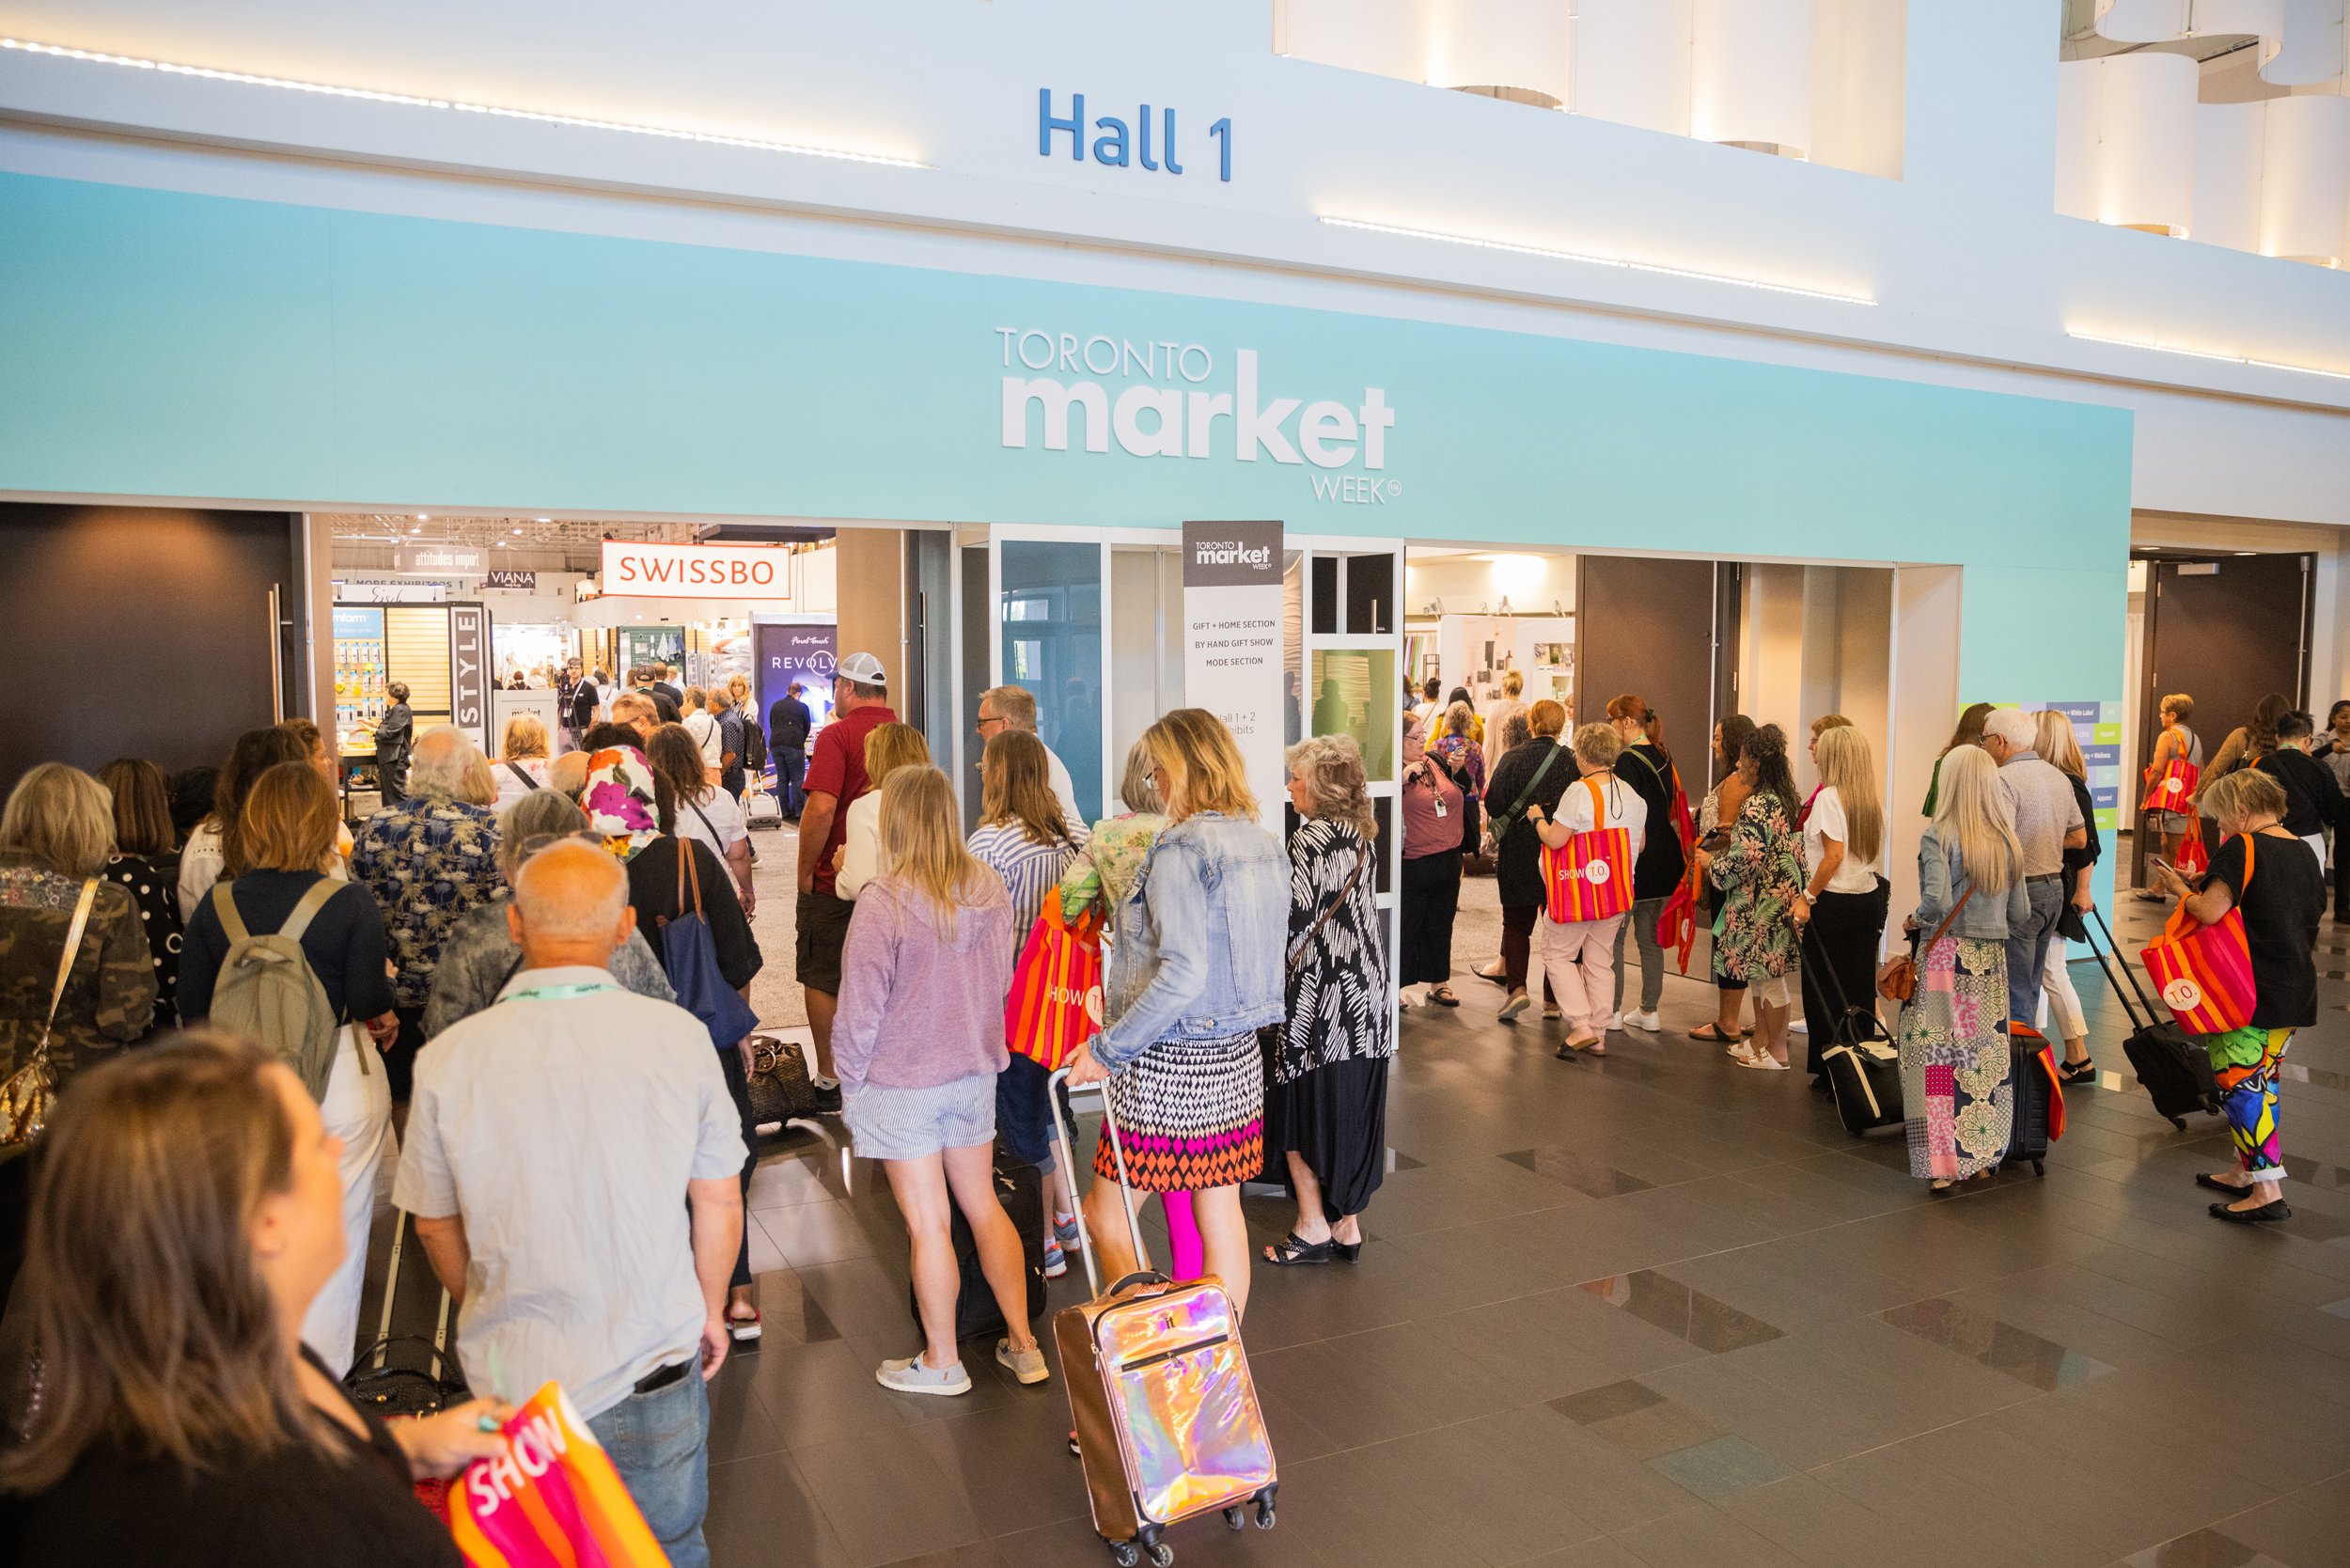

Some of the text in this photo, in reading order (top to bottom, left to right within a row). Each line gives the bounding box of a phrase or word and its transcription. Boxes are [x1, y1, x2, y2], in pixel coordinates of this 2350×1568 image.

[1040, 87, 1231, 181] Hall 1
[995, 326, 1213, 383] TORONTO
[1002, 348, 1395, 470] market
[1196, 541, 1235, 551] TORONTO
[1197, 541, 1271, 564] market
[415, 550, 453, 566] attitudes
[455, 550, 479, 569] import
[491, 572, 534, 584] VIANA
[619, 557, 774, 586] SWISSBO
[1218, 620, 1241, 629] HOME
[1243, 619, 1276, 628] SECTION
[1207, 639, 1230, 648] HAND
[458, 617, 479, 724] STYLE
[1206, 656, 1263, 666] MODE SECTION
[1250, 712, 1256, 722] 2
[1559, 869, 1585, 881] SHOW
[2170, 985, 2198, 1004] T.O.
[471, 1406, 567, 1517] SHOW
